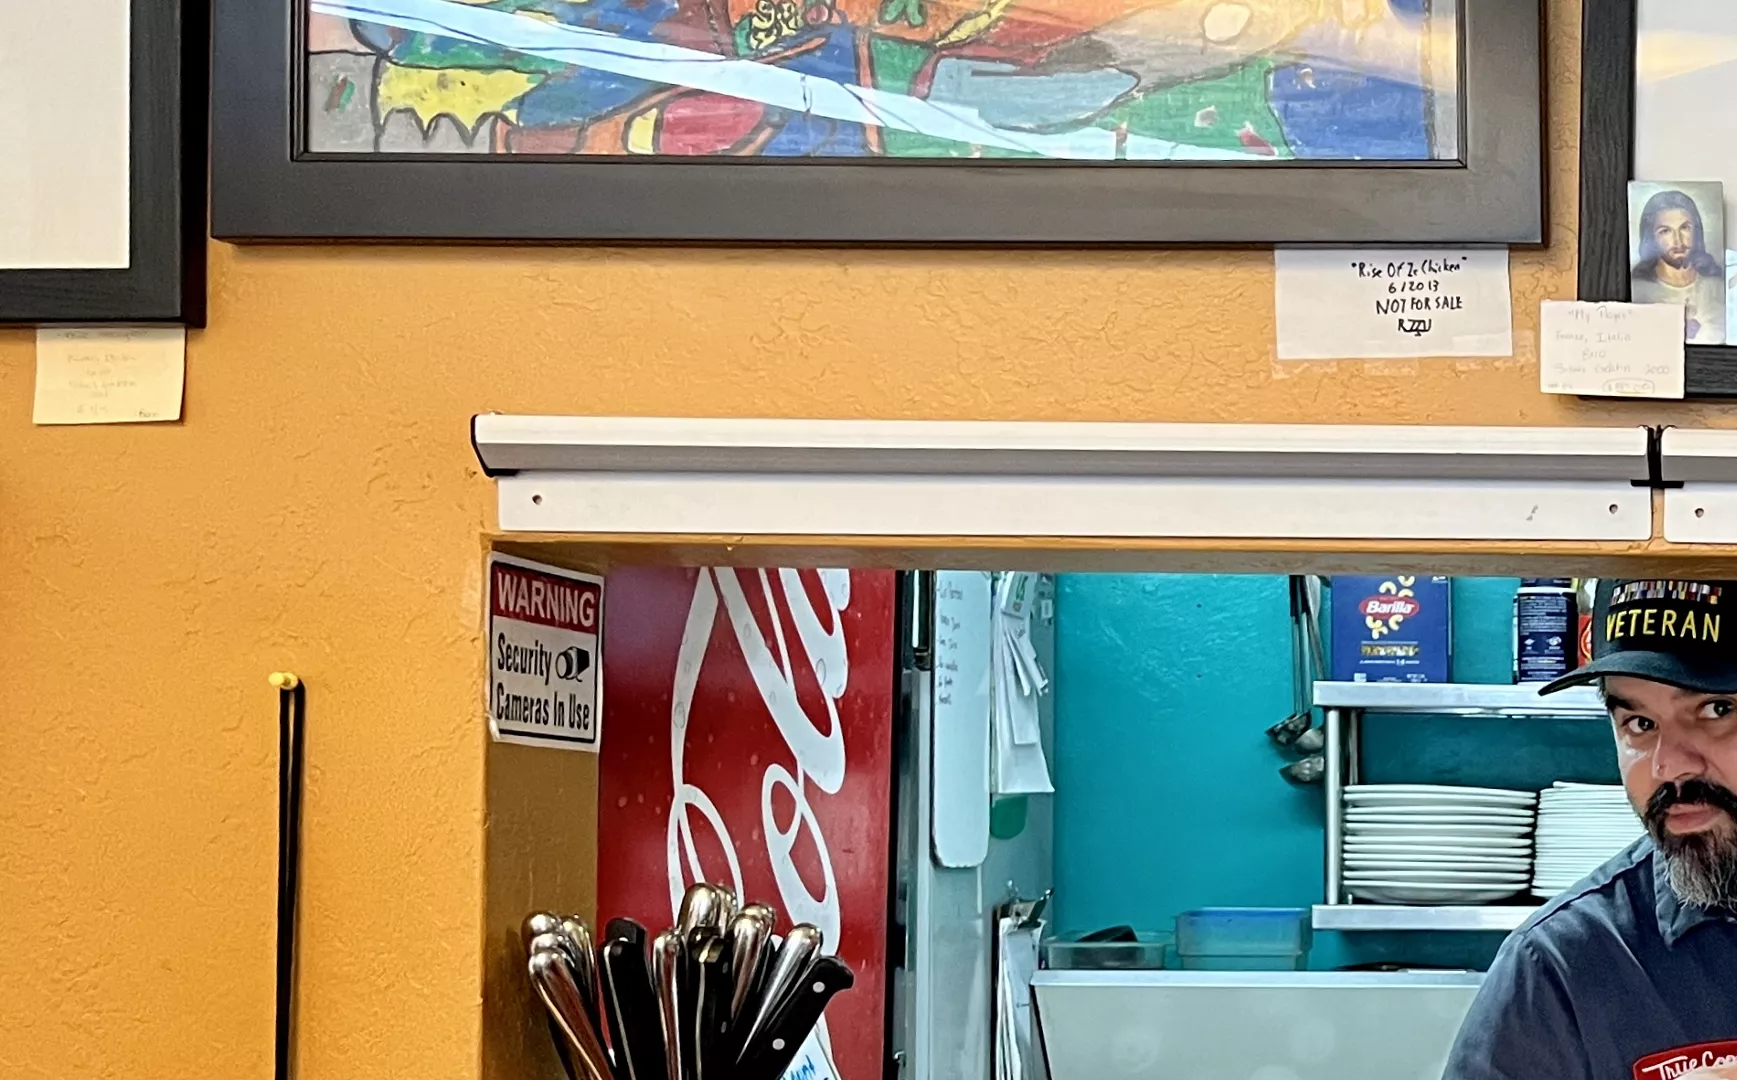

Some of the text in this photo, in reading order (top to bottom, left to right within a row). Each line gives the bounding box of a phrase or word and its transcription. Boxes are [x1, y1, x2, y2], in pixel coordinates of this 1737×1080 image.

[1376, 296, 1462, 315] NOT FOR SALE
[498, 572, 595, 627] WARNING
[1366, 600, 1415, 614] Barilla
[1606, 608, 1721, 643] VETERAN
[497, 633, 552, 686] Security
[496, 683, 590, 731] Cameras In Use
